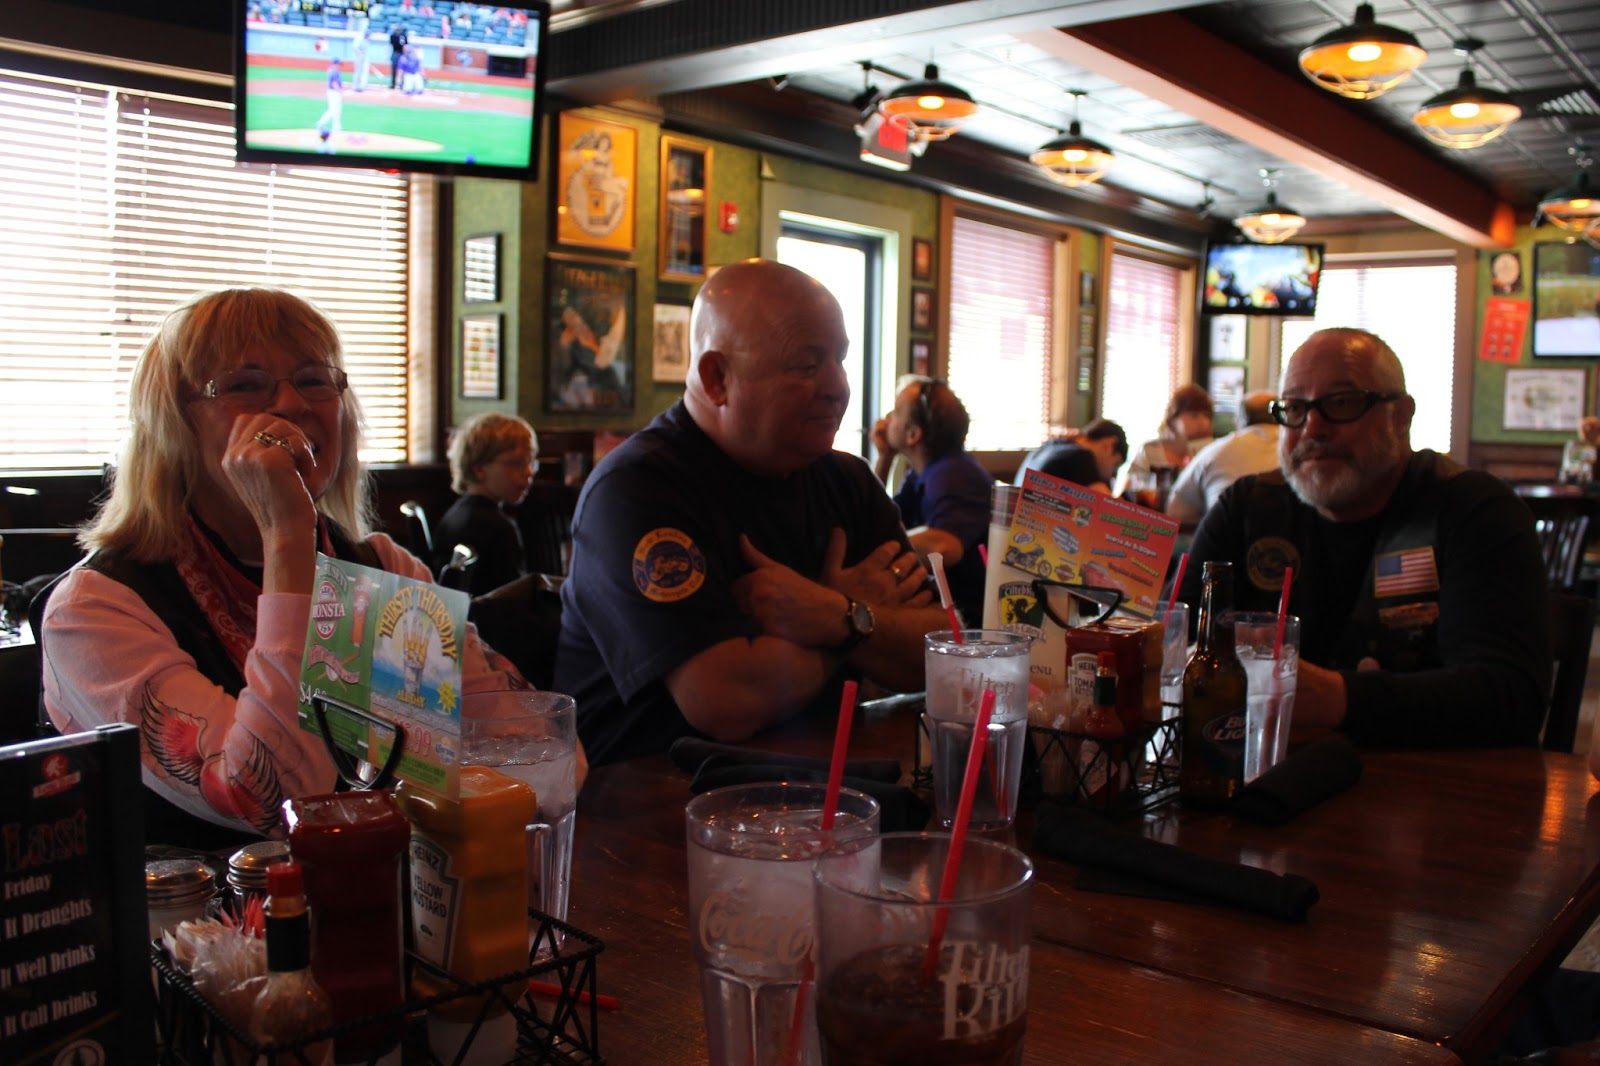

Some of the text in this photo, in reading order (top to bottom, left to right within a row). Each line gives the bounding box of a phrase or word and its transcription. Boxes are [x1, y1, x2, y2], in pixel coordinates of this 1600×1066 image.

[379, 586, 458, 662] THIRSTY THURSDAY
[1030, 664, 1052, 676] enu
[1079, 662, 1097, 672] HEIN
[1074, 676, 1095, 689] TOMA
[1214, 728, 1246, 741] LIG
[1224, 715, 1246, 730] Bu
[3, 872, 52, 900] Friday
[414, 874, 443, 899] YELLOW
[21, 897, 93, 936] Draughts
[15, 955, 48, 984] Well
[49, 944, 97, 974] Drinks
[20, 1002, 49, 1031] Call
[51, 990, 98, 1022] Drinks
